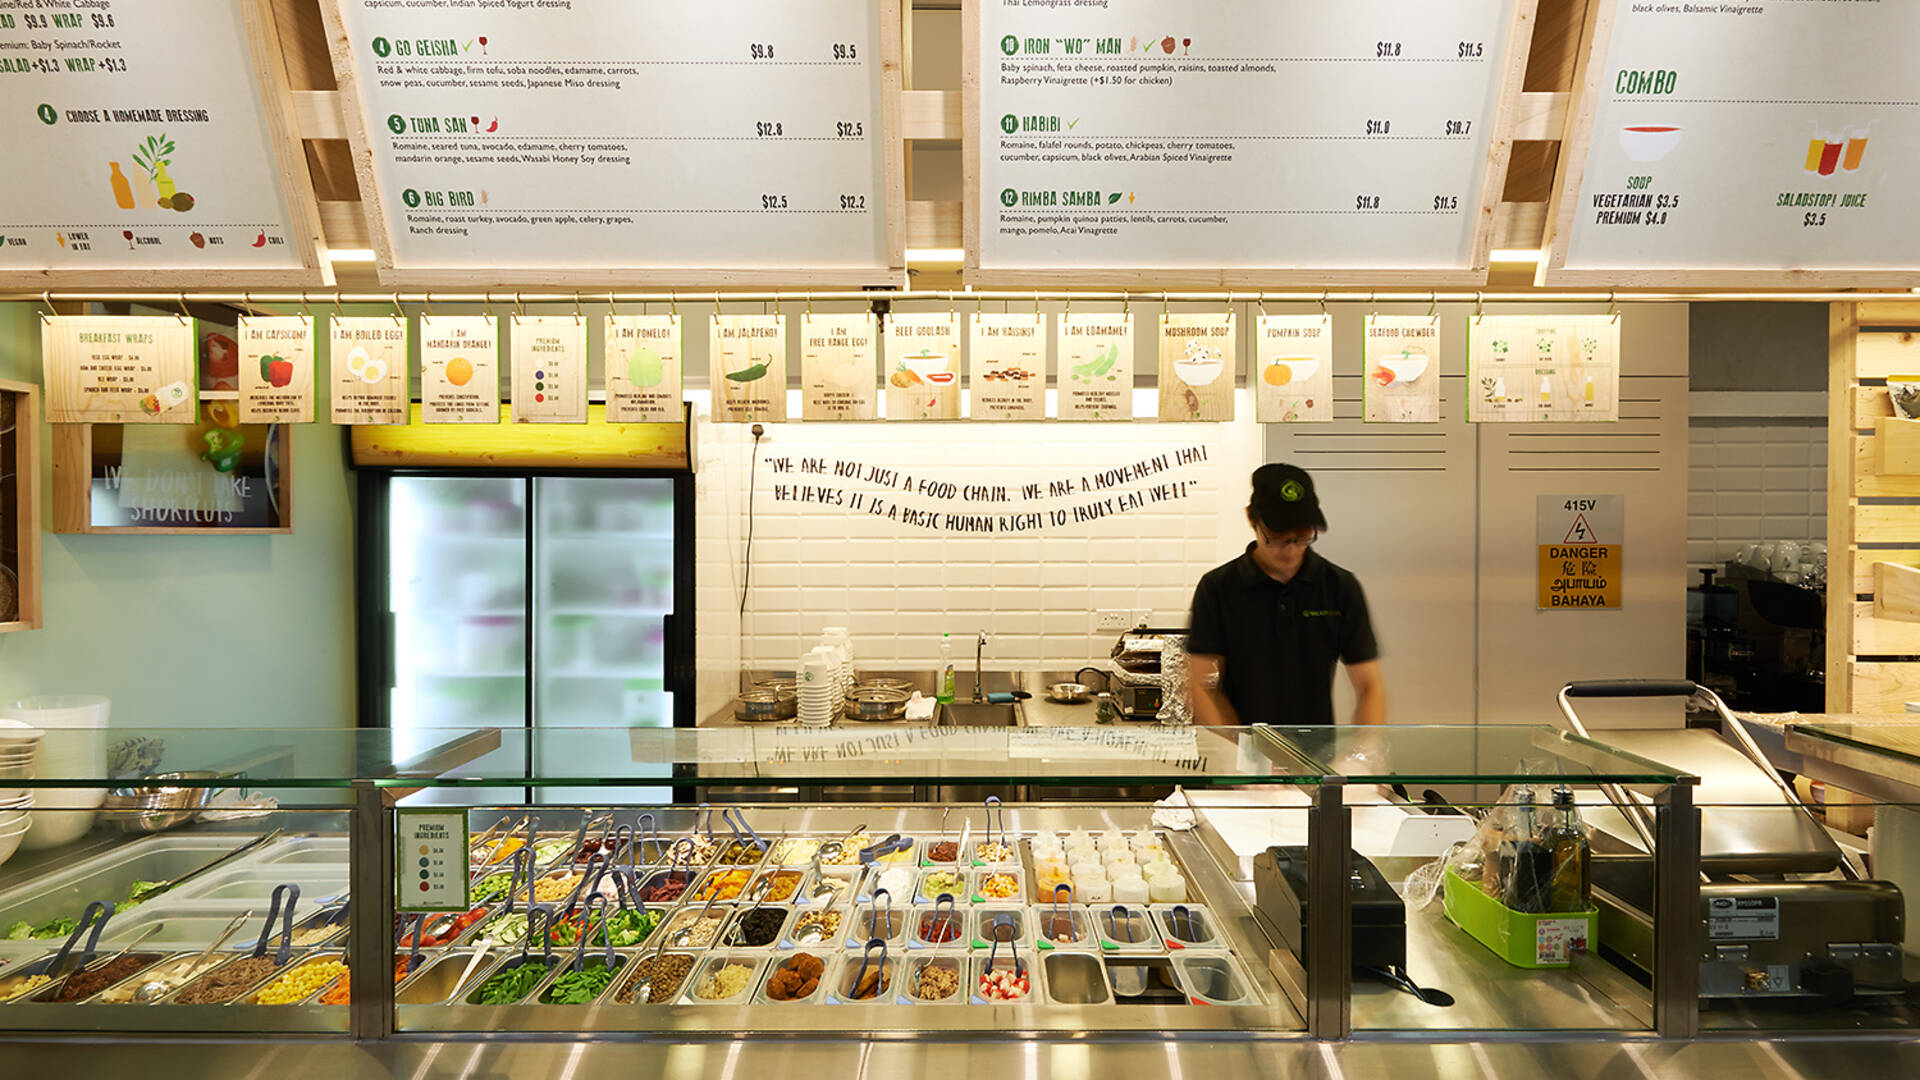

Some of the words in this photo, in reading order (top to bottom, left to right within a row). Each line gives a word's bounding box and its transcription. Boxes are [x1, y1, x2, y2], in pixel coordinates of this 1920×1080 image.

[1631, 3, 1654, 13] black
[1655, 3, 1682, 15] olives,
[1682, 3, 1719, 14] Balsamic
[1719, 4, 1764, 16] Vinaigrette
[0, 13, 16, 29] AD
[23, 13, 48, 30] $9.9
[50, 12, 83, 29] WRAP
[90, 12, 115, 30] $9.6
[30, 39, 53, 53] Baby
[53, 38, 122, 52] Spinach/Rocket
[394, 39, 412, 57] GO
[415, 38, 459, 57] GEISHA
[750, 42, 775, 61] $9.8
[832, 42, 857, 61] $9.5
[1023, 37, 1051, 55] IRON
[1055, 37, 1091, 55] "WO"
[1095, 37, 1122, 55] MAN
[1376, 40, 1402, 58] $11.8
[1457, 40, 1483, 59] $11.5
[63, 56, 96, 73] WRAP
[97, 56, 128, 74] +$1.3
[376, 64, 395, 75] Red
[395, 65, 404, 75] &
[403, 65, 429, 75] white
[429, 65, 467, 78] cabbage,
[466, 65, 485, 75] firm
[485, 64, 507, 76] tofu,
[506, 65, 527, 75] soba
[527, 65, 564, 76] noodles,
[564, 65, 607, 76] edamame,
[606, 67, 640, 76] carrots,
[1000, 75, 1042, 88] Raspberry
[1042, 75, 1088, 88] Vinaigrette
[1089, 75, 1123, 87] (+$1.50
[1123, 75, 1137, 85] for
[1138, 75, 1173, 87] chicken)
[1615, 69, 1678, 95] COMBO
[64, 109, 101, 124] CHOOSE
[102, 109, 111, 123] A
[112, 108, 163, 123] HOMEMADE
[165, 108, 210, 123] DRESSING
[409, 116, 441, 134] TUNA
[443, 116, 468, 134] SAN
[756, 120, 783, 138] $12.8
[836, 120, 863, 138] $12.5
[1022, 115, 1061, 133] HABIBI
[1365, 119, 1391, 136] $11.0
[1445, 119, 1472, 136] $10.7
[392, 141, 431, 152] Romaine,
[431, 141, 459, 151] seared
[459, 143, 481, 152] tuna,
[481, 141, 517, 152] avocado,
[516, 141, 558, 152] edamame,
[558, 141, 586, 153] cherry
[587, 143, 628, 152] tomatoes,
[999, 140, 1038, 150] Romaine,
[1038, 139, 1063, 150] falafel
[1063, 140, 1095, 150] rounds,
[1094, 142, 1125, 152] potato,
[1124, 140, 1166, 152] chickpeas,
[1166, 140, 1194, 152] cherry
[1194, 142, 1236, 151] tomatoes,
[1626, 175, 1653, 191] SOUP
[424, 190, 445, 207] BIG
[447, 190, 475, 207] BIRD
[761, 193, 788, 210] $12.5
[839, 193, 866, 210] $12.2
[1021, 190, 1058, 207] RIMBA
[1061, 190, 1101, 207] SAMBA
[1356, 194, 1381, 211] $11.8
[1433, 194, 1458, 211] $11.5
[1592, 193, 1654, 209] VEGETARIAN
[1655, 193, 1680, 210] $3.5
[1776, 192, 1838, 208] SALADSTOP!
[1838, 193, 1868, 208] JUICE
[1595, 210, 1642, 225] PREMIUM
[1644, 210, 1668, 227] $4.0
[1803, 211, 1827, 228] $3.5
[67, 232, 90, 242] LOWER
[409, 225, 435, 235] Ranch
[435, 225, 469, 237] dressing
[999, 227, 1028, 237] mango,
[1027, 225, 1060, 236] pomelo,
[1059, 225, 1077, 235] Acai
[1076, 225, 1119, 237] Vinagrette
[250, 329, 263, 341] AM
[265, 329, 307, 341] CAPSICUM!
[339, 329, 353, 340] AM
[355, 329, 383, 341] BOILED
[384, 329, 404, 341] EGG!
[456, 328, 467, 338] AM
[895, 325, 913, 337] BEEF
[916, 325, 951, 337] GOULASH
[1070, 325, 1083, 336] AM
[1085, 325, 1128, 337] EDAMAME!
[1164, 326, 1208, 338] MUSHROOM
[1210, 326, 1230, 337] SOUP
[1266, 327, 1300, 339] PUMPKIN
[1302, 327, 1321, 338] SOUP
[1369, 327, 1400, 338] SEAFOOD
[1401, 327, 1436, 339] CHOWDER
[79, 332, 121, 345] BREAKFAST
[125, 333, 153, 345] WRAPS
[426, 339, 461, 349] MANDARIN
[462, 339, 492, 349] ORANGE!
[802, 458, 827, 474] ARE
[834, 460, 862, 479] NOT
[864, 466, 898, 487] JUST
[904, 476, 912, 491] A
[919, 479, 956, 499] FOOD
[963, 484, 1010, 502] CHAIN.
[1022, 483, 1043, 500] WE
[1050, 479, 1074, 497] ARE
[1082, 476, 1091, 492] A
[1095, 454, 1169, 490] MOVEMENT
[1176, 445, 1208, 466] THAT
[775, 485, 843, 505] BELIEVES
[850, 493, 863, 509] IT
[869, 498, 883, 515] IS
[888, 504, 896, 520] A
[902, 507, 939, 530] BASIC
[945, 514, 993, 532] HUMAN
[1000, 512, 1042, 532] RIGHT
[1050, 509, 1066, 526] TO
[1073, 499, 1113, 523] TRULY
[1119, 491, 1144, 512] EAT
[1564, 500, 1596, 511] 415V
[1550, 547, 1608, 558] DANGER
[1552, 595, 1605, 606] BAHAYA
